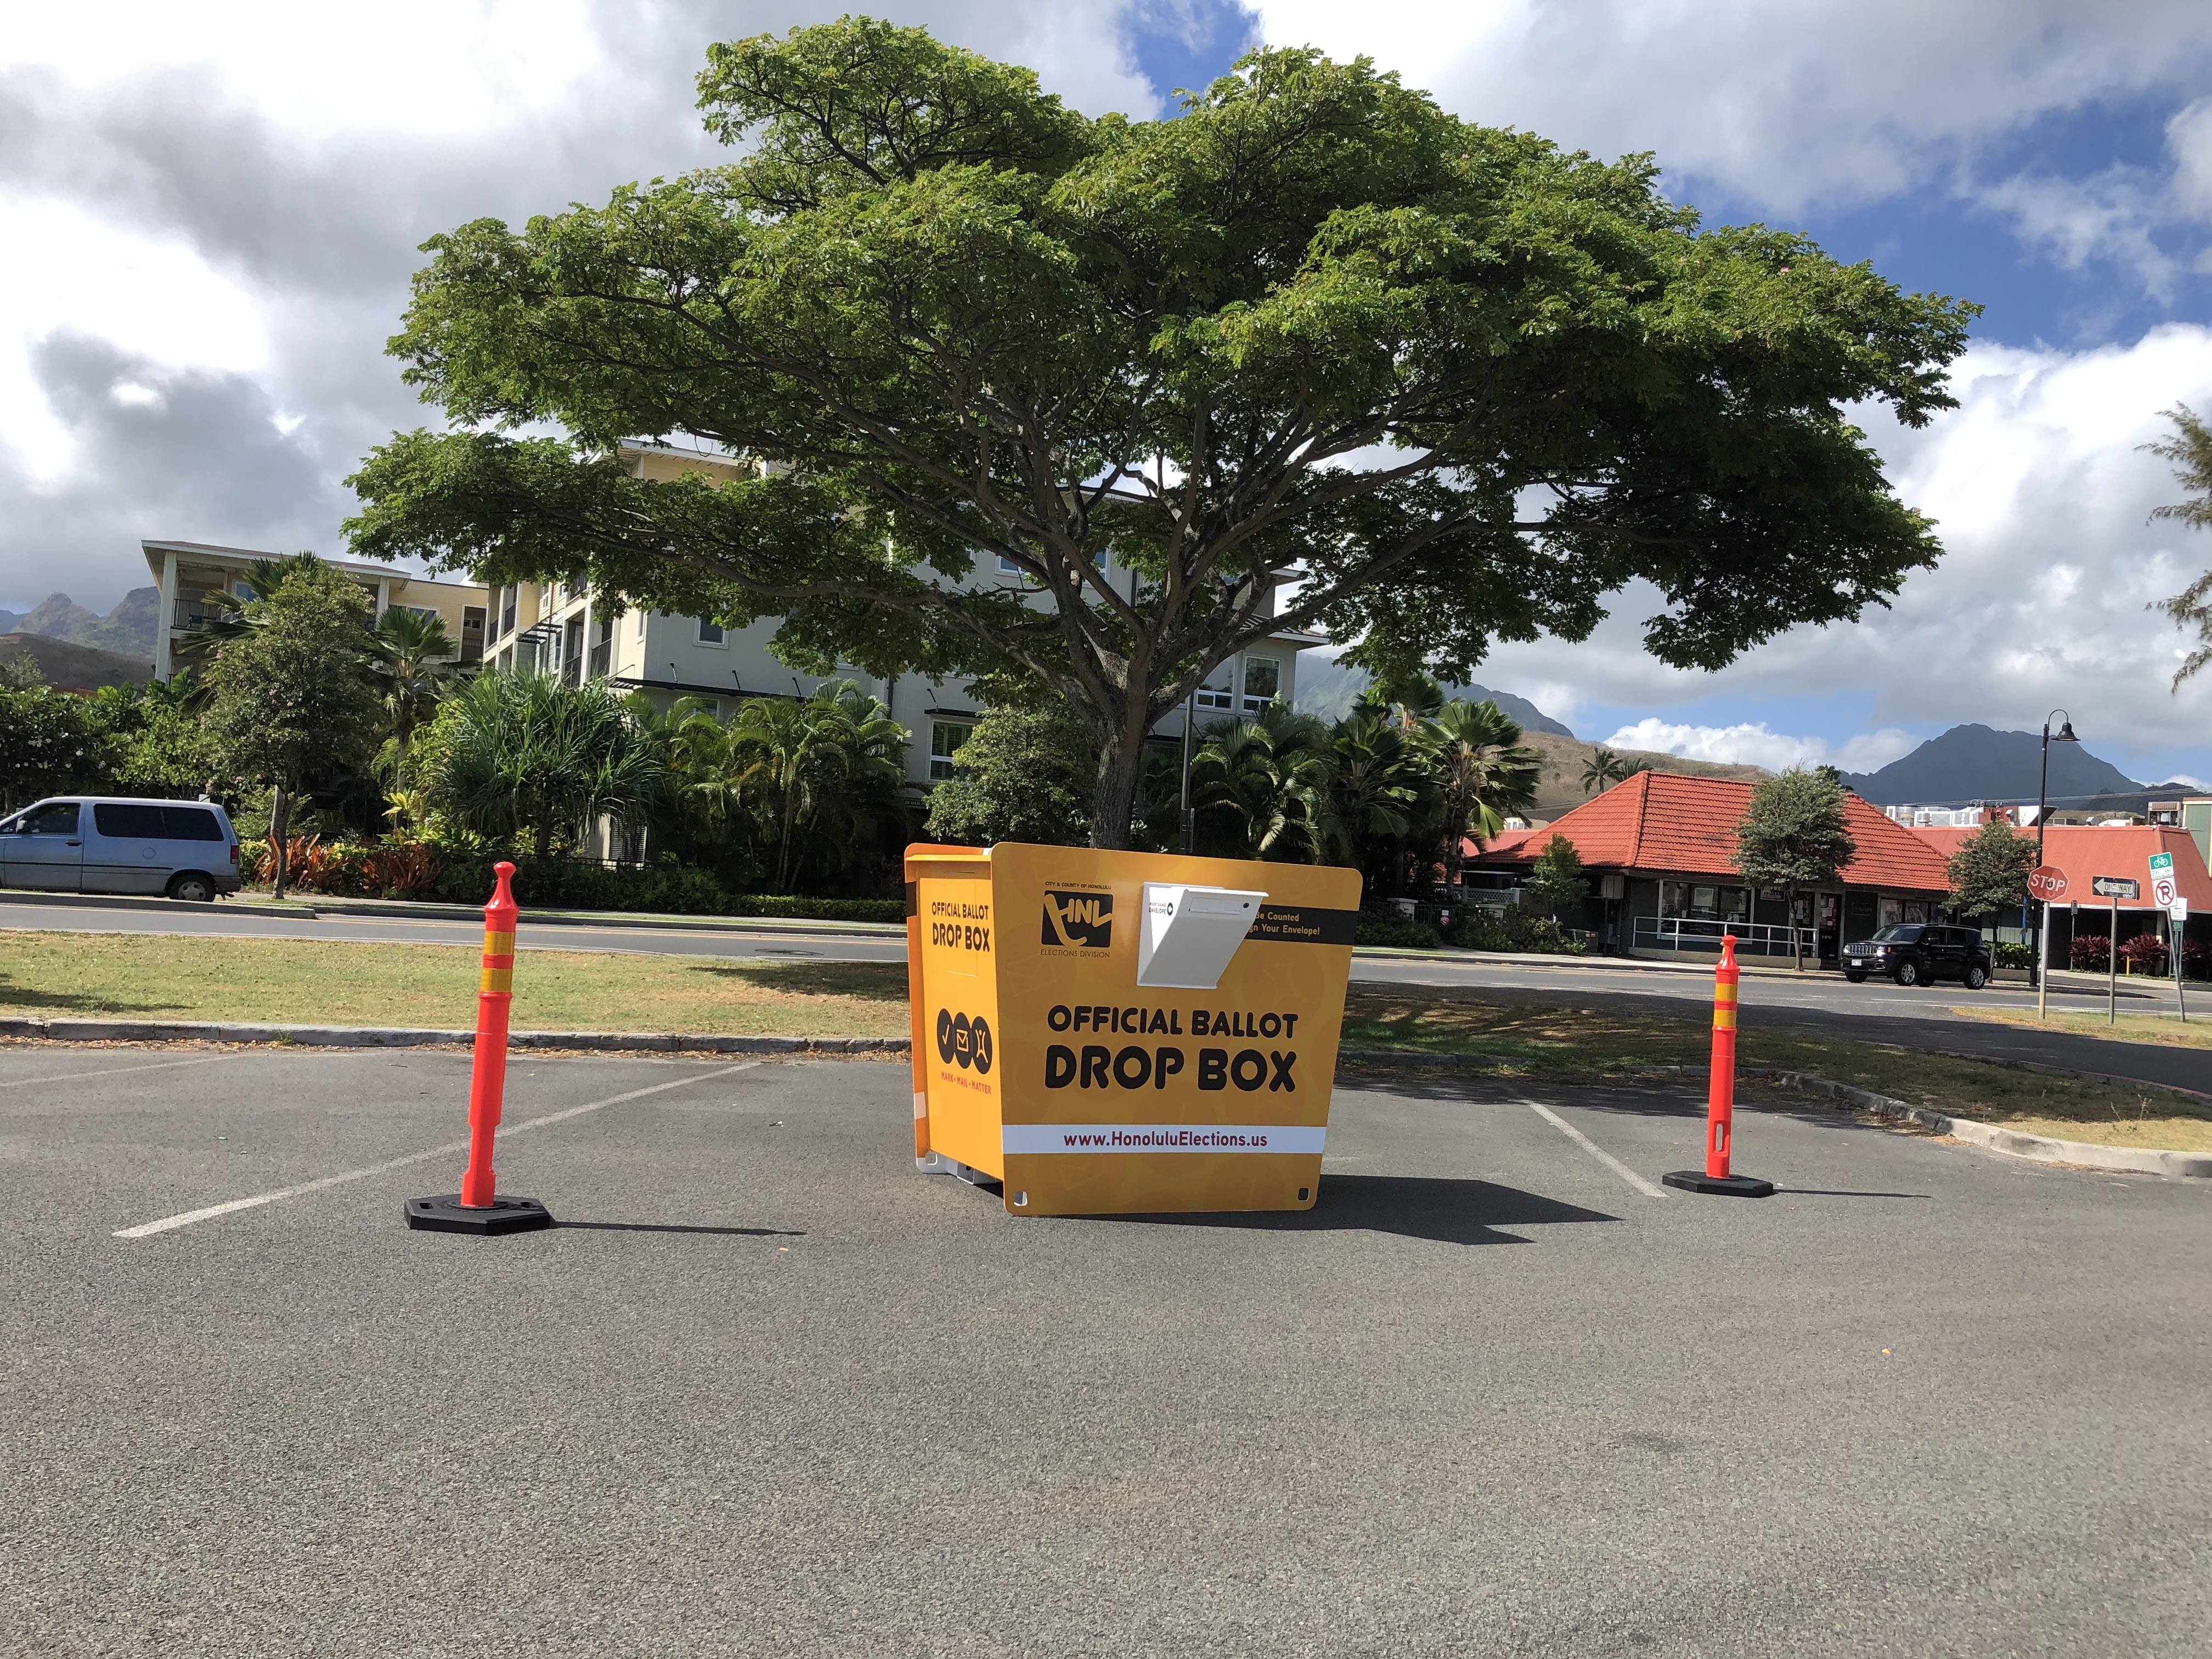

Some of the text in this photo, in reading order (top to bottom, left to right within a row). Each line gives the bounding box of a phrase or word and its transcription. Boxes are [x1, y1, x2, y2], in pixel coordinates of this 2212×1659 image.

[2031, 874, 2066, 891] STOP
[2118, 884, 2131, 893] WAY
[2160, 885, 2170, 901] P
[932, 901, 989, 921] OFFICIAL BALLOT
[1267, 911, 1300, 922] Counted
[1043, 893, 1113, 948] HNL
[933, 922, 990, 952] DROP BOX
[1262, 923, 1280, 933] Your
[1283, 924, 1321, 937] Envelope!
[1047, 1005, 1299, 1039] OFFICIAL BALLOT
[1045, 1045, 1297, 1093] DROP BOX
[941, 1071, 991, 1095] MARK MAIL MATTER
[1063, 1130, 1268, 1147] www.HonoluluElections.us
